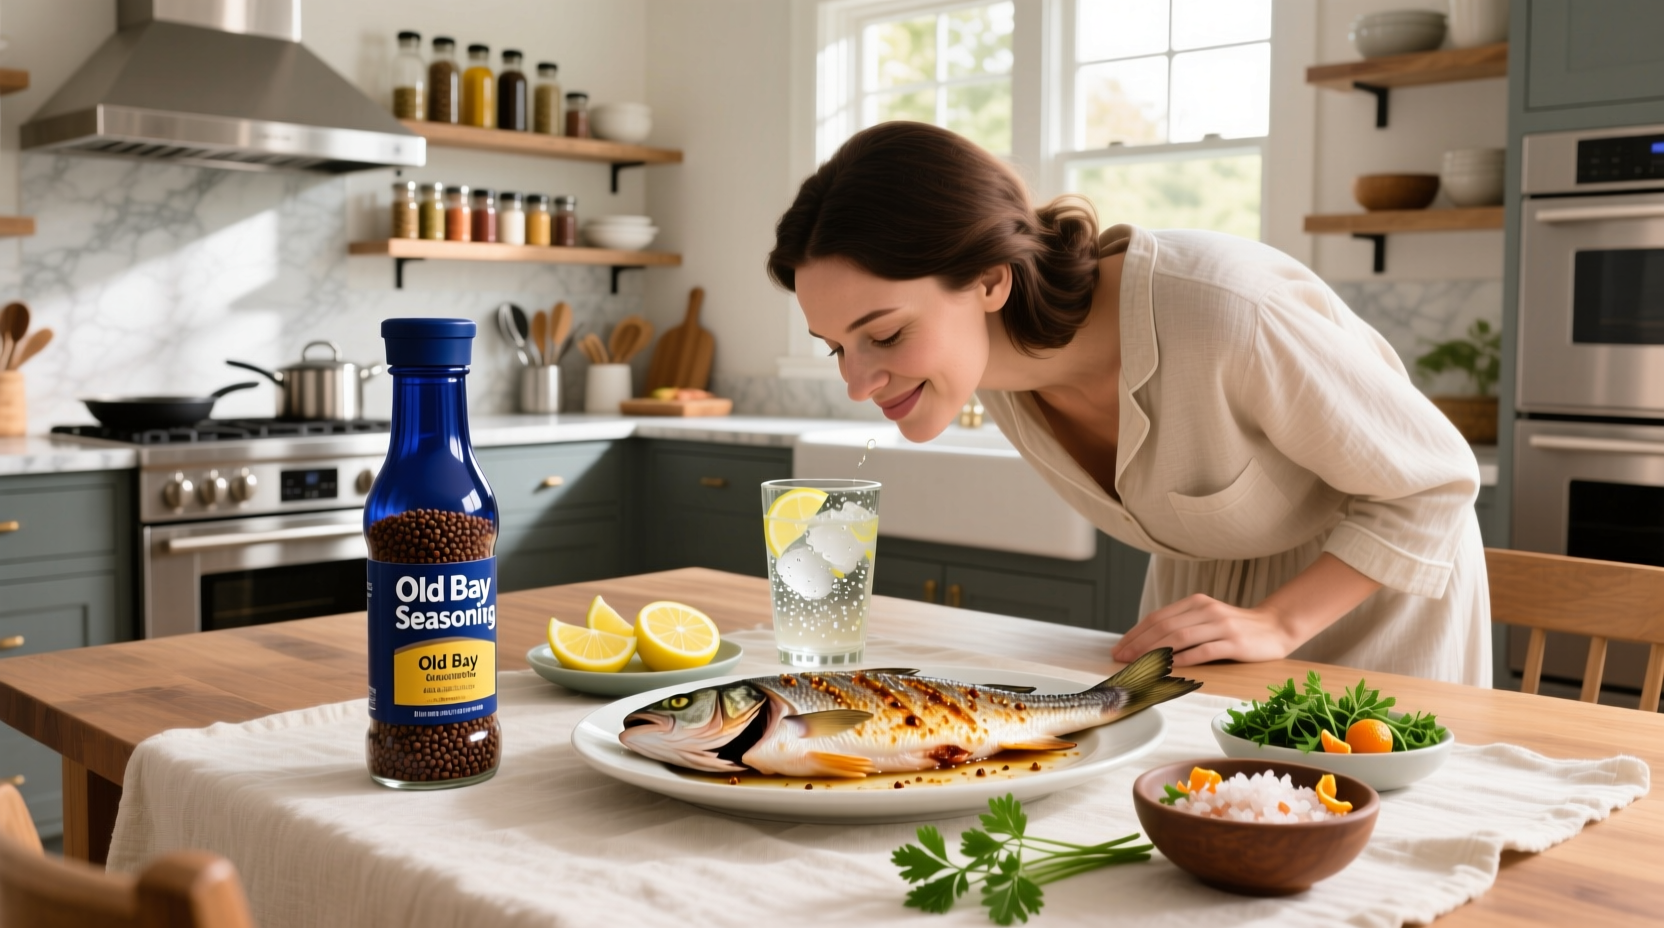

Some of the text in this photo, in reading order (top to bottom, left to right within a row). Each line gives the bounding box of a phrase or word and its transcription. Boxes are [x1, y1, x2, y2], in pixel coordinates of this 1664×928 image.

[395, 575, 445, 603] Old
[450, 574, 492, 605] Bay
[418, 653, 478, 671] Old Bay
